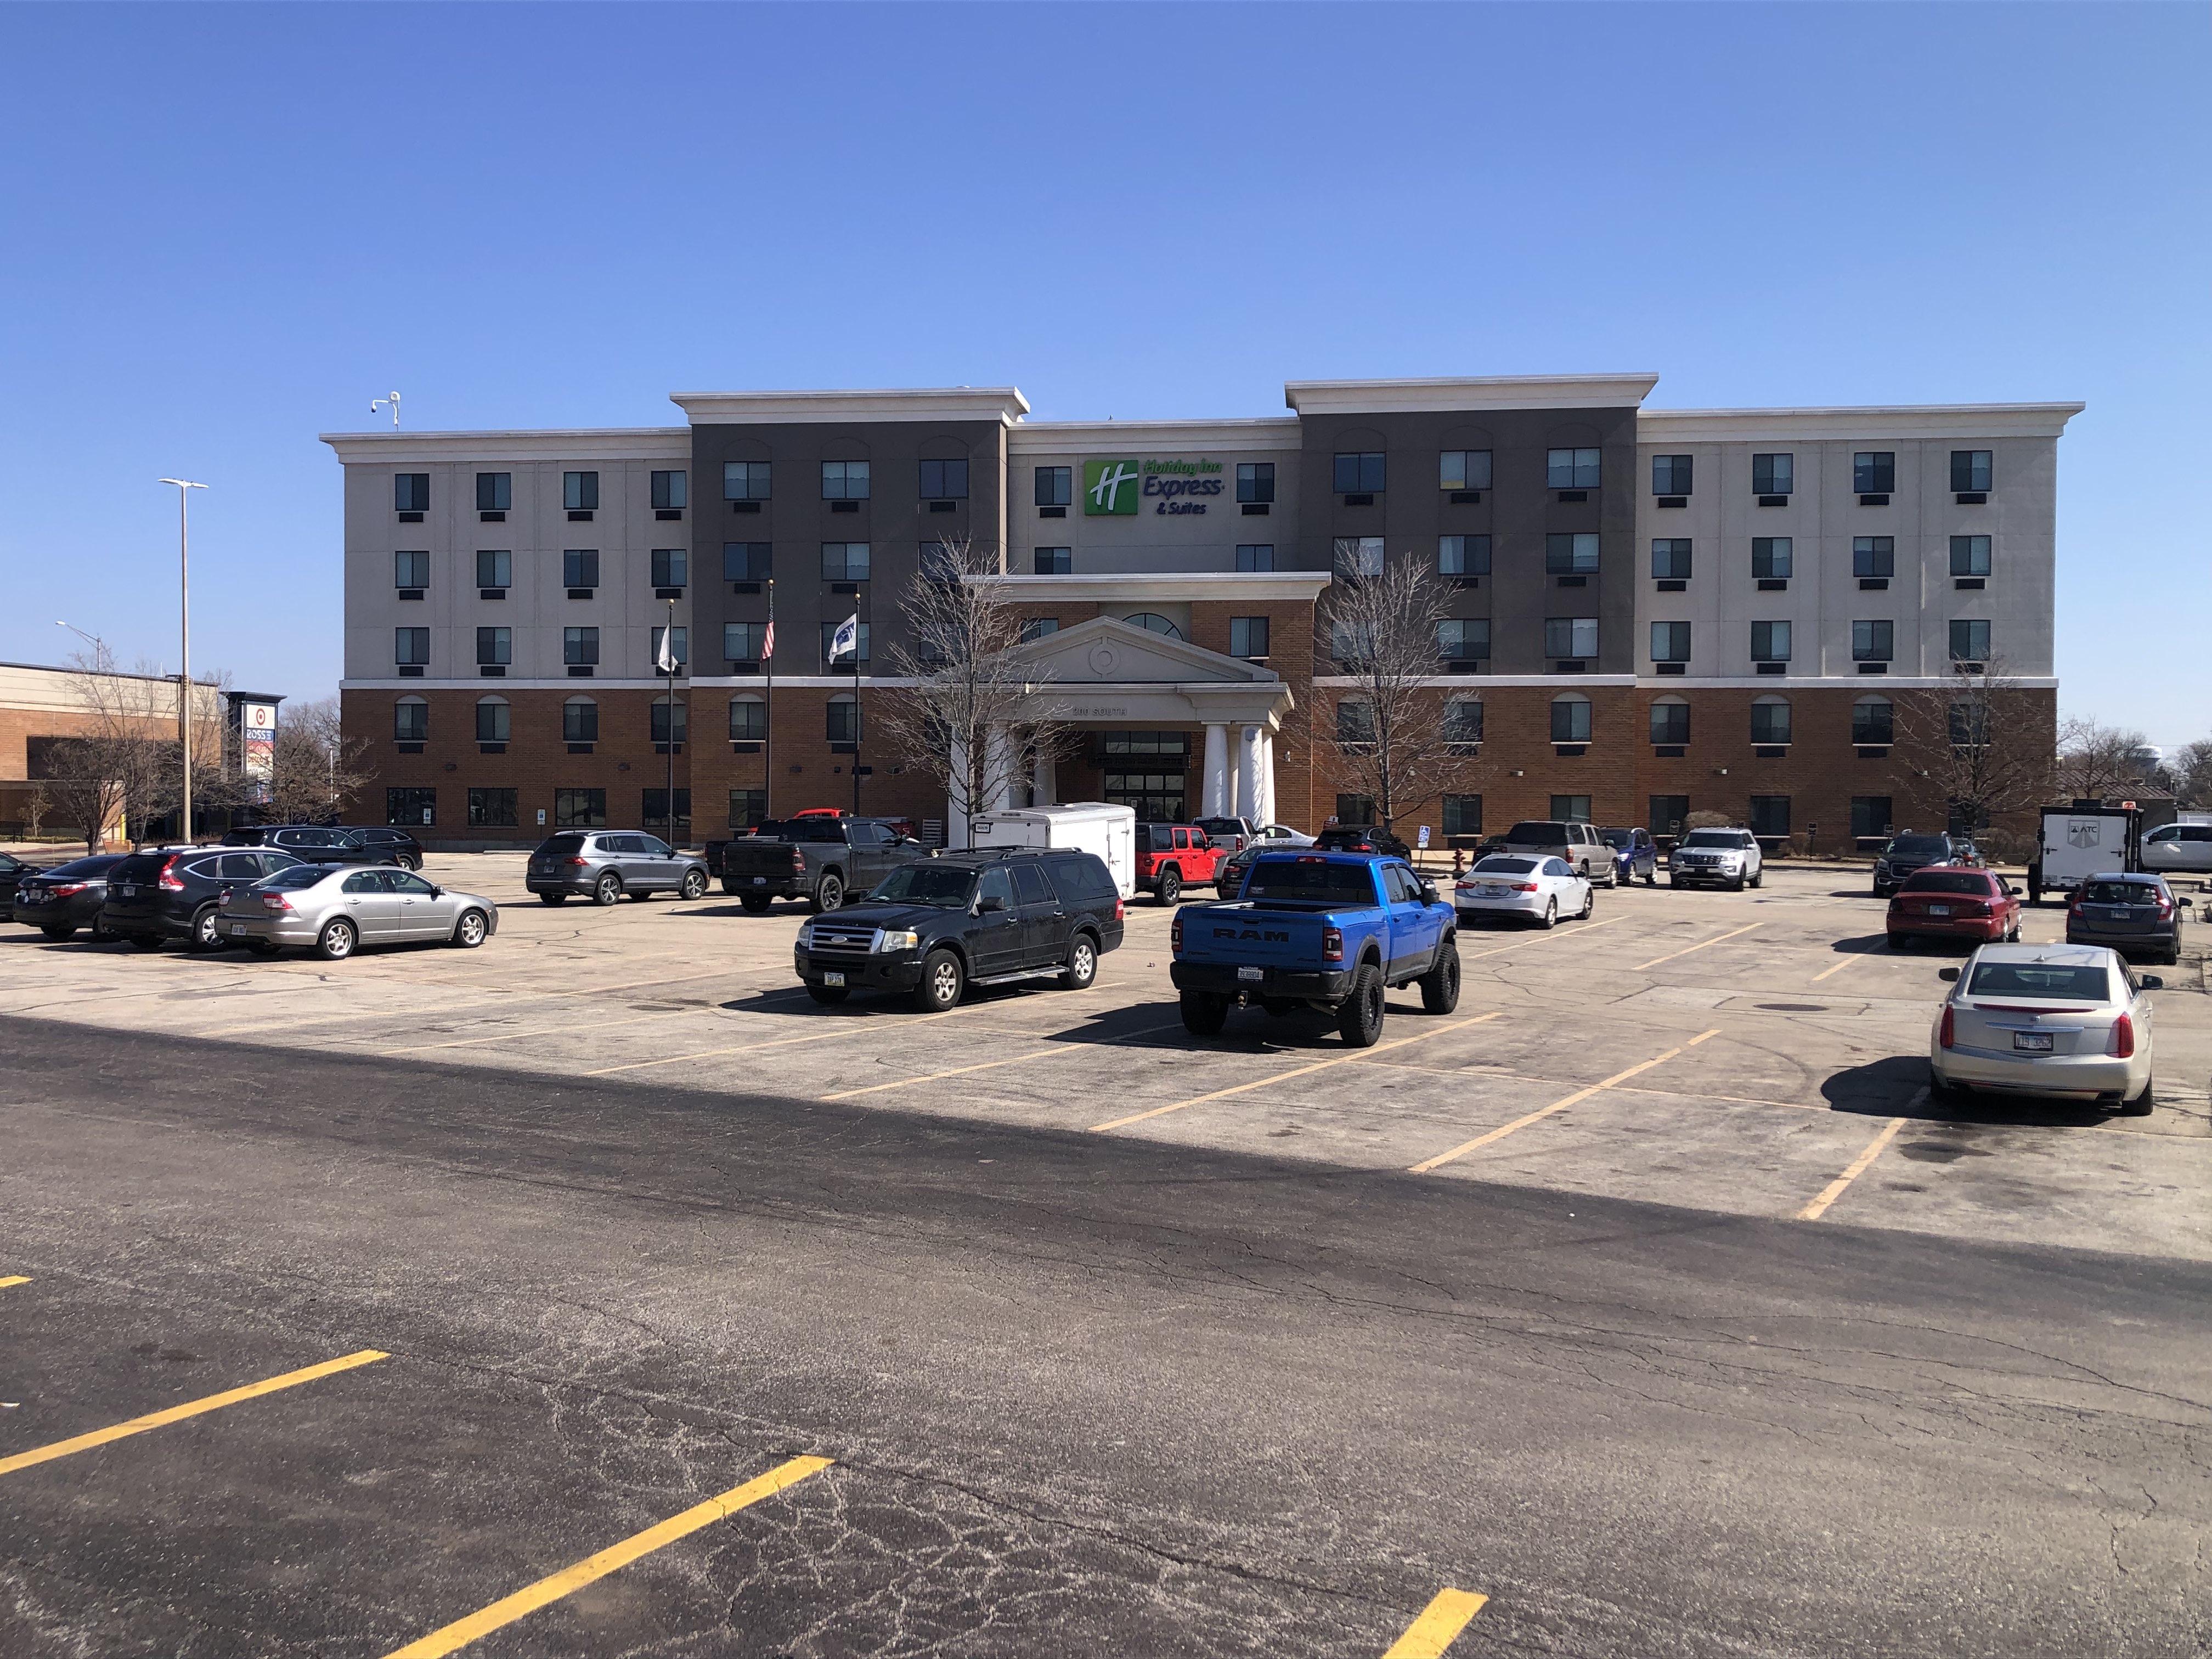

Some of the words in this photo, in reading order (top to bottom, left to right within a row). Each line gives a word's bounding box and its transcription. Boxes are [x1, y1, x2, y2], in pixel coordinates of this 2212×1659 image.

[1144, 459, 1197, 476] Holiday
[1144, 476, 1222, 500] Express
[1157, 502, 1166, 515] &
[1168, 502, 1206, 514] Suites
[1073, 707, 1089, 716] 200
[1093, 707, 1127, 716] SOUTH
[1213, 928, 1289, 942] RAM
